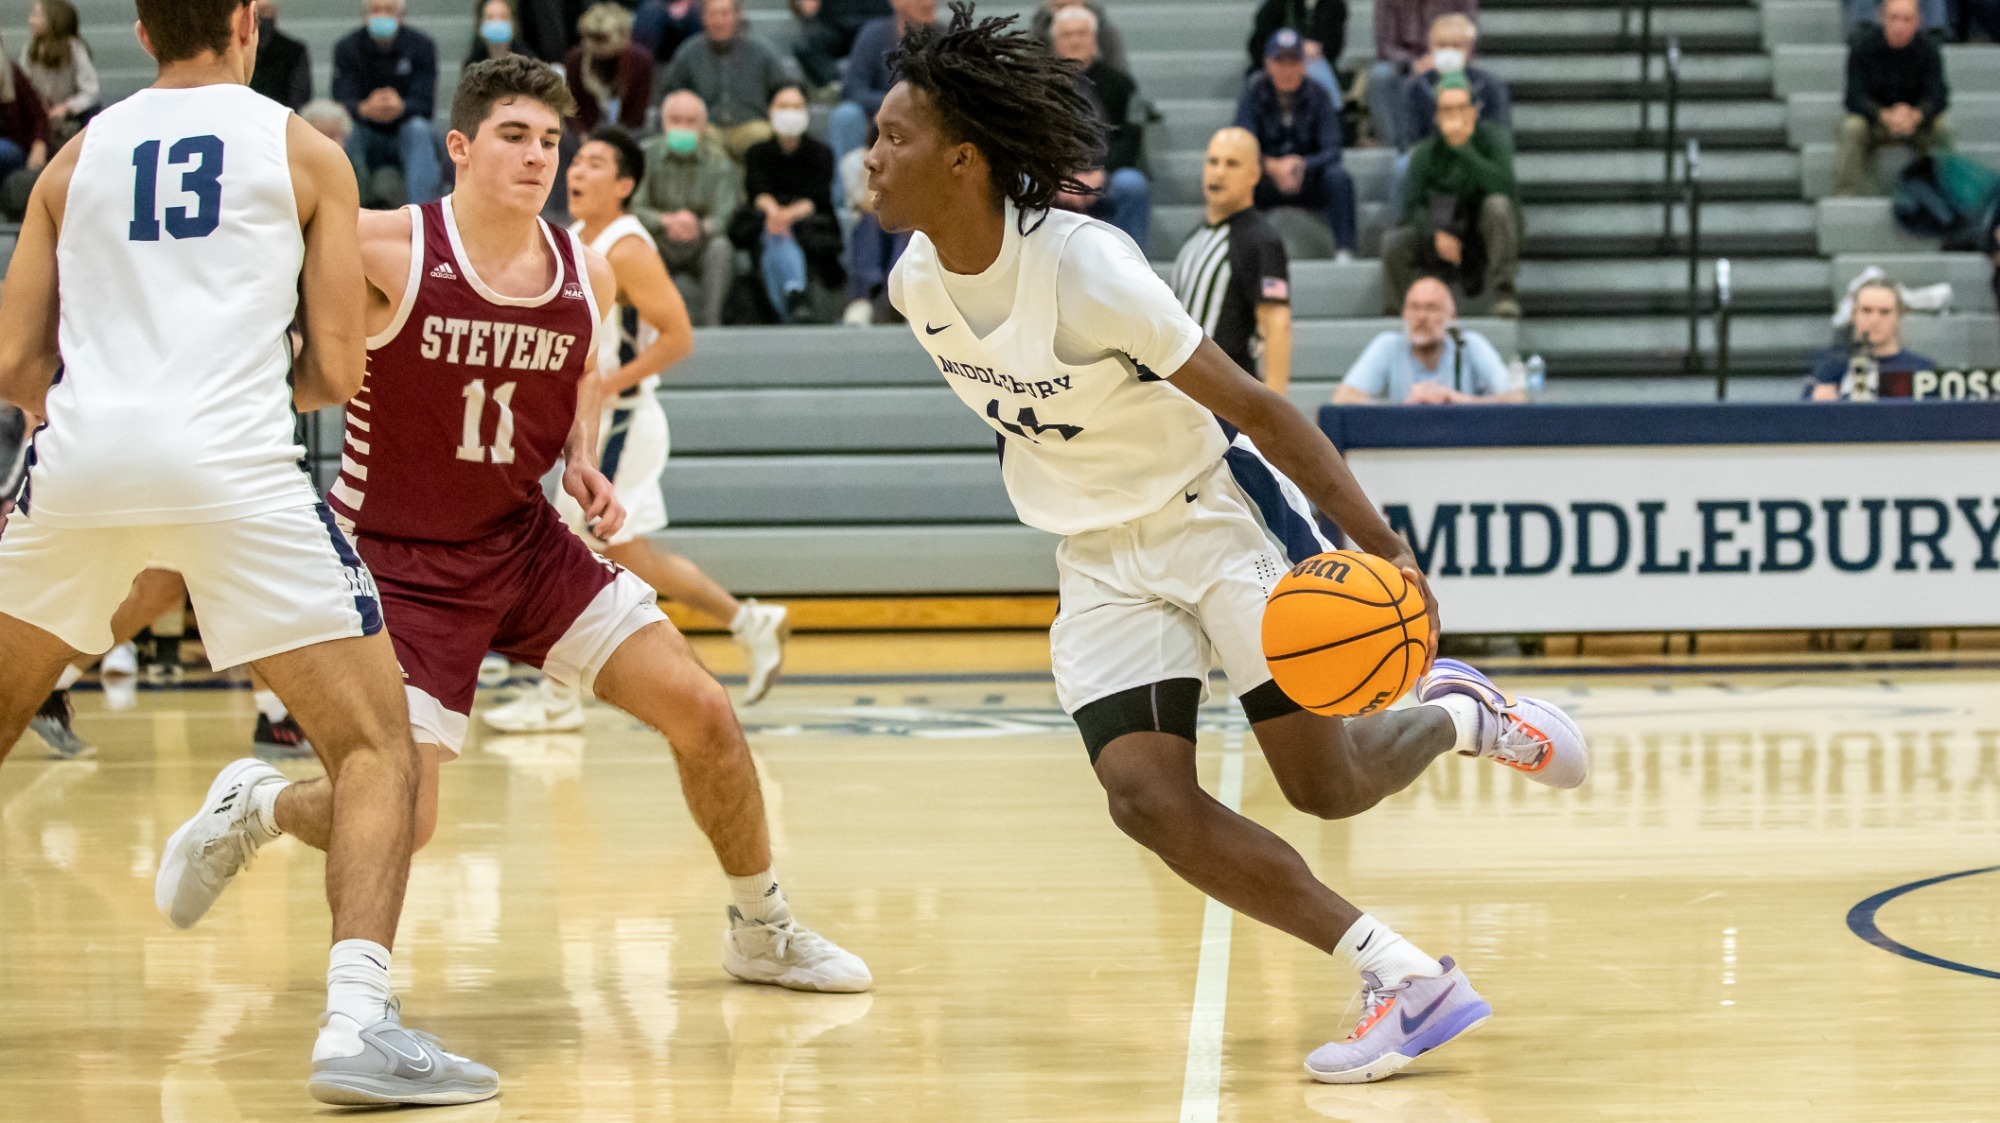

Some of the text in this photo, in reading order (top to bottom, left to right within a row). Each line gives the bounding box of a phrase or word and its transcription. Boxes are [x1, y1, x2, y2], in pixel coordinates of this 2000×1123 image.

[128, 135, 224, 241] 13
[430, 271, 457, 280] adidas
[420, 315, 576, 371] STEVENS
[456, 378, 517, 464] 11
[1383, 498, 2000, 576] MIDDLEBURY
[1290, 559, 1351, 584] Wil
